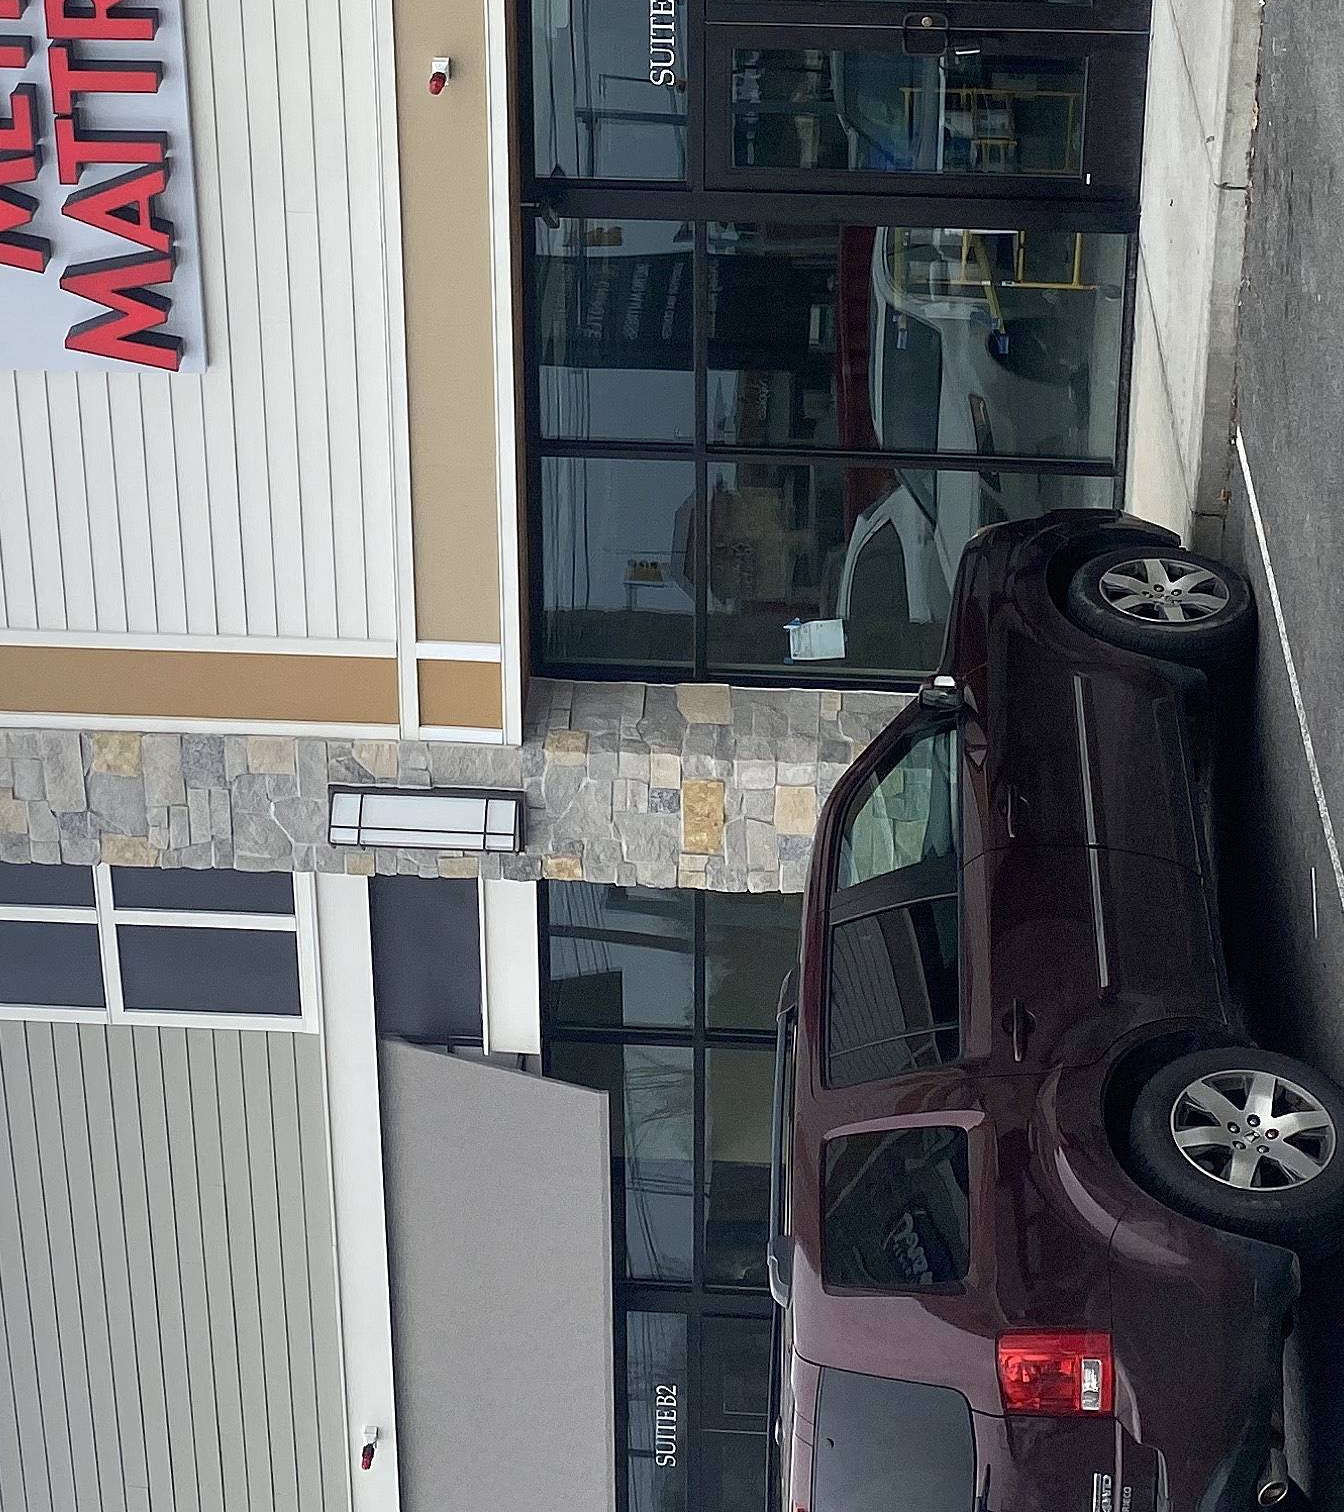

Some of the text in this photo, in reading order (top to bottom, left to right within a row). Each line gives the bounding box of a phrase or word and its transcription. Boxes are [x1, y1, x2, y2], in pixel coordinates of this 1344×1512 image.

[649, 0, 675, 86] SUITE
[655, 1384, 676, 1467] SUITE B2
